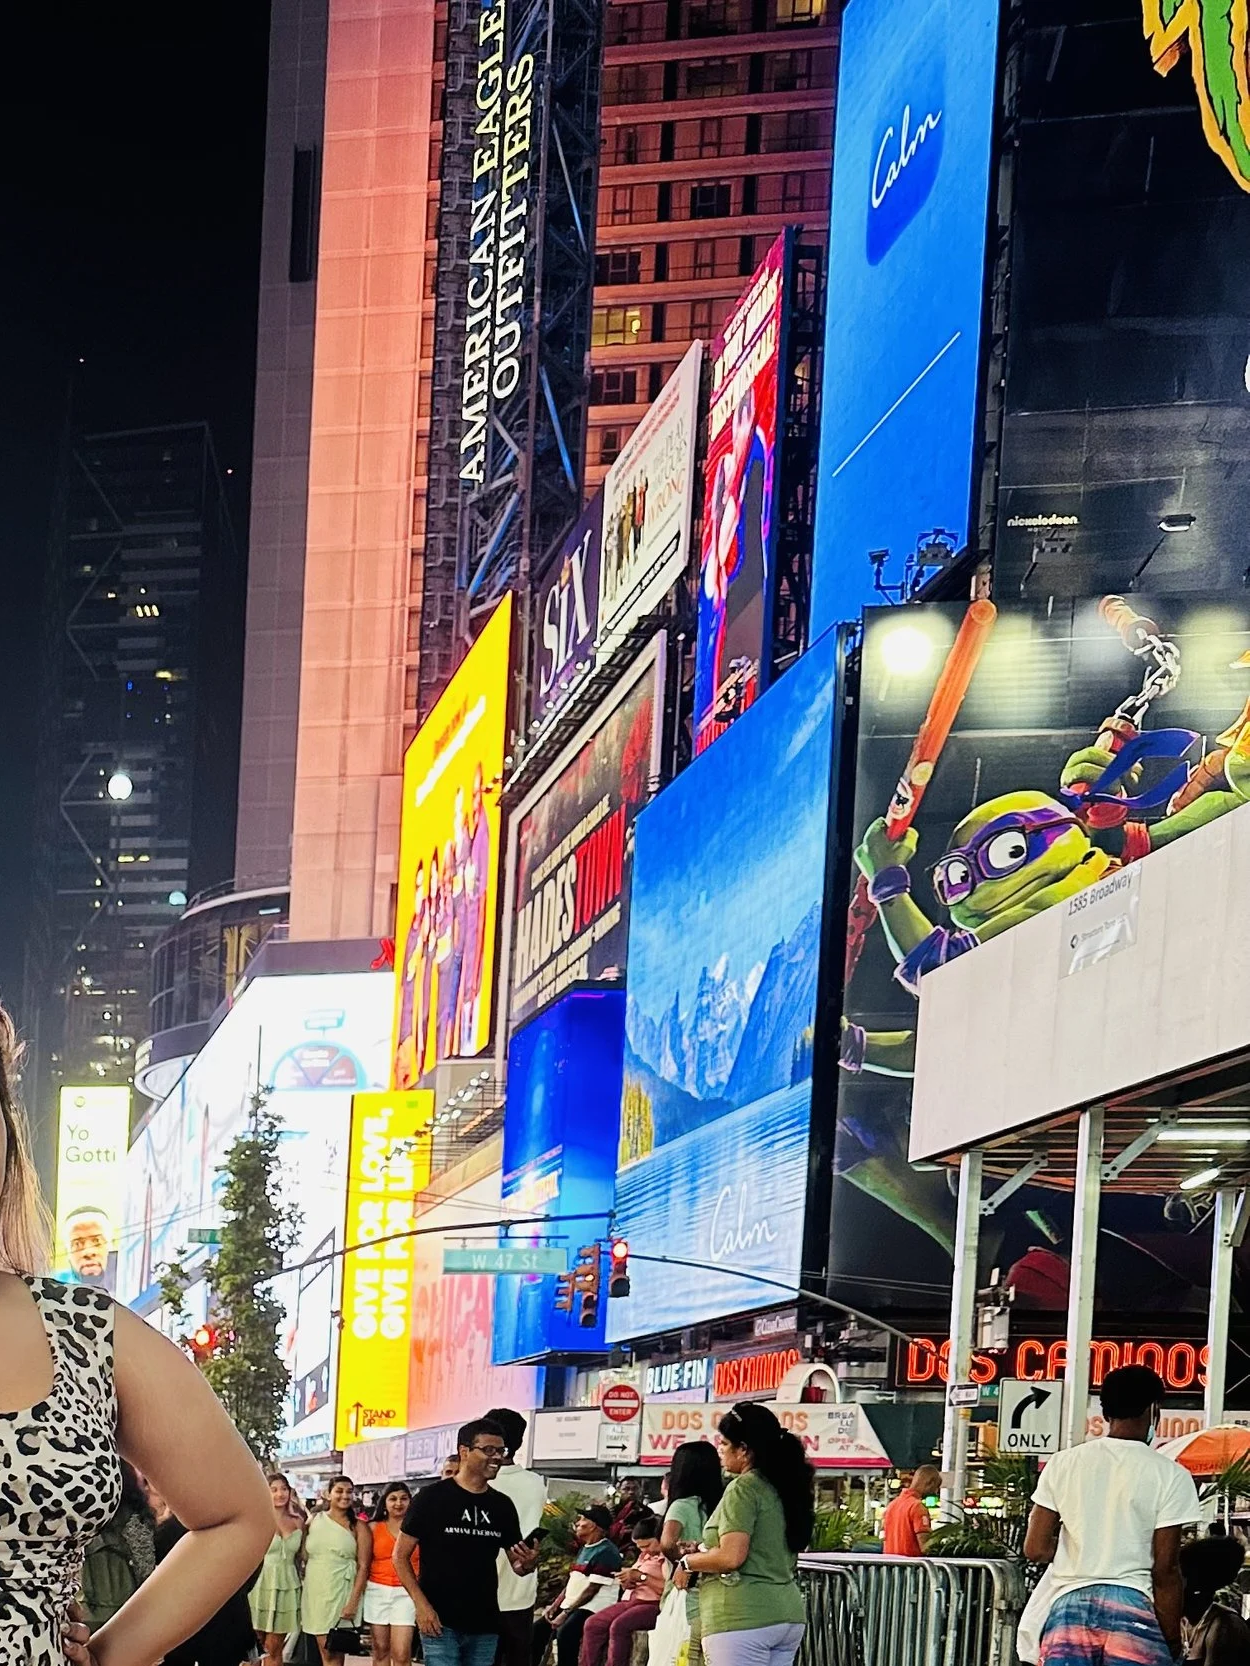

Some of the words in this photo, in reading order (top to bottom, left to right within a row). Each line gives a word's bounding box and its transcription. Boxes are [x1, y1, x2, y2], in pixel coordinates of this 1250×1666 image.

[473, 0, 506, 185] EAGLE
[871, 105, 943, 209] Calm
[491, 53, 535, 400] OUTFITTERS
[459, 189, 498, 484] AMERICAN
[1007, 513, 1079, 528] nickelodeon
[1068, 892, 1089, 916] 1585
[1090, 871, 1134, 905] Broadway
[66, 1124, 90, 1141] Yo
[65, 1145, 117, 1163] Gotti
[708, 1184, 778, 1262] Calm
[472, 1254, 487, 1270] W
[495, 1253, 515, 1270] 47
[522, 1253, 538, 1270] St
[647, 1361, 678, 1395] BLUE
[683, 1357, 708, 1389] FIN
[713, 1360, 738, 1397] DOS
[363, 1409, 396, 1420] STAND
[363, 1418, 375, 1428] UP
[661, 1410, 703, 1431] DOS
[1007, 1433, 1052, 1448] ONLY
